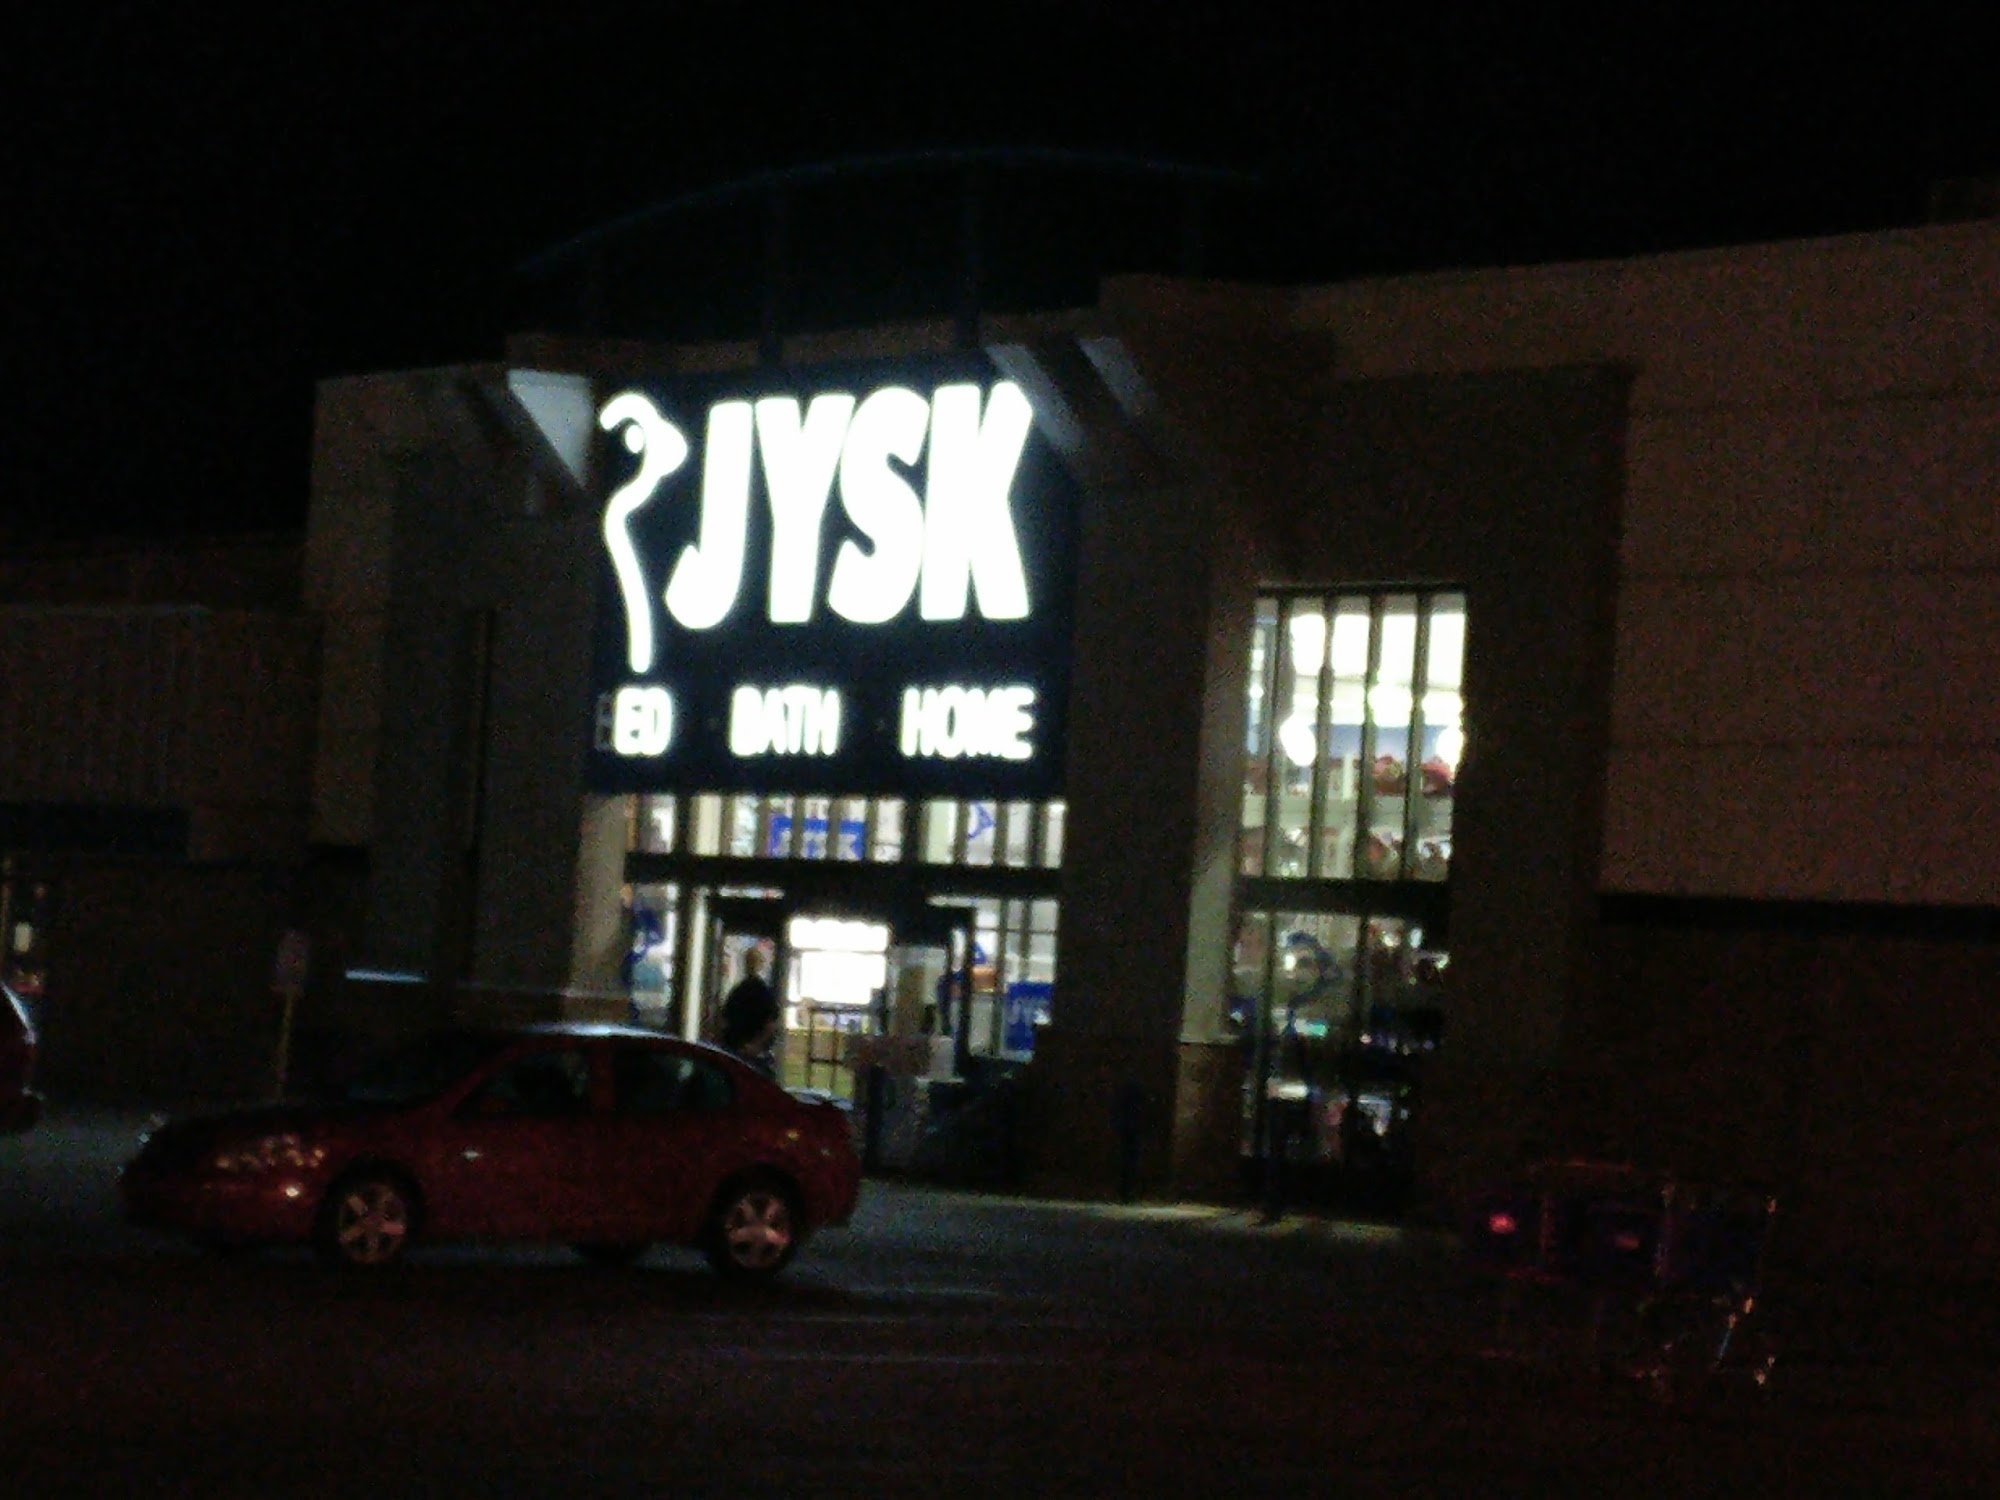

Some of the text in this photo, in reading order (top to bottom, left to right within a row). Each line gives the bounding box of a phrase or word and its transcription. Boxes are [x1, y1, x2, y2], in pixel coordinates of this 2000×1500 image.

[664, 380, 1034, 630] JYSK
[730, 684, 842, 757] BATH
[901, 684, 1036, 760] HOME
